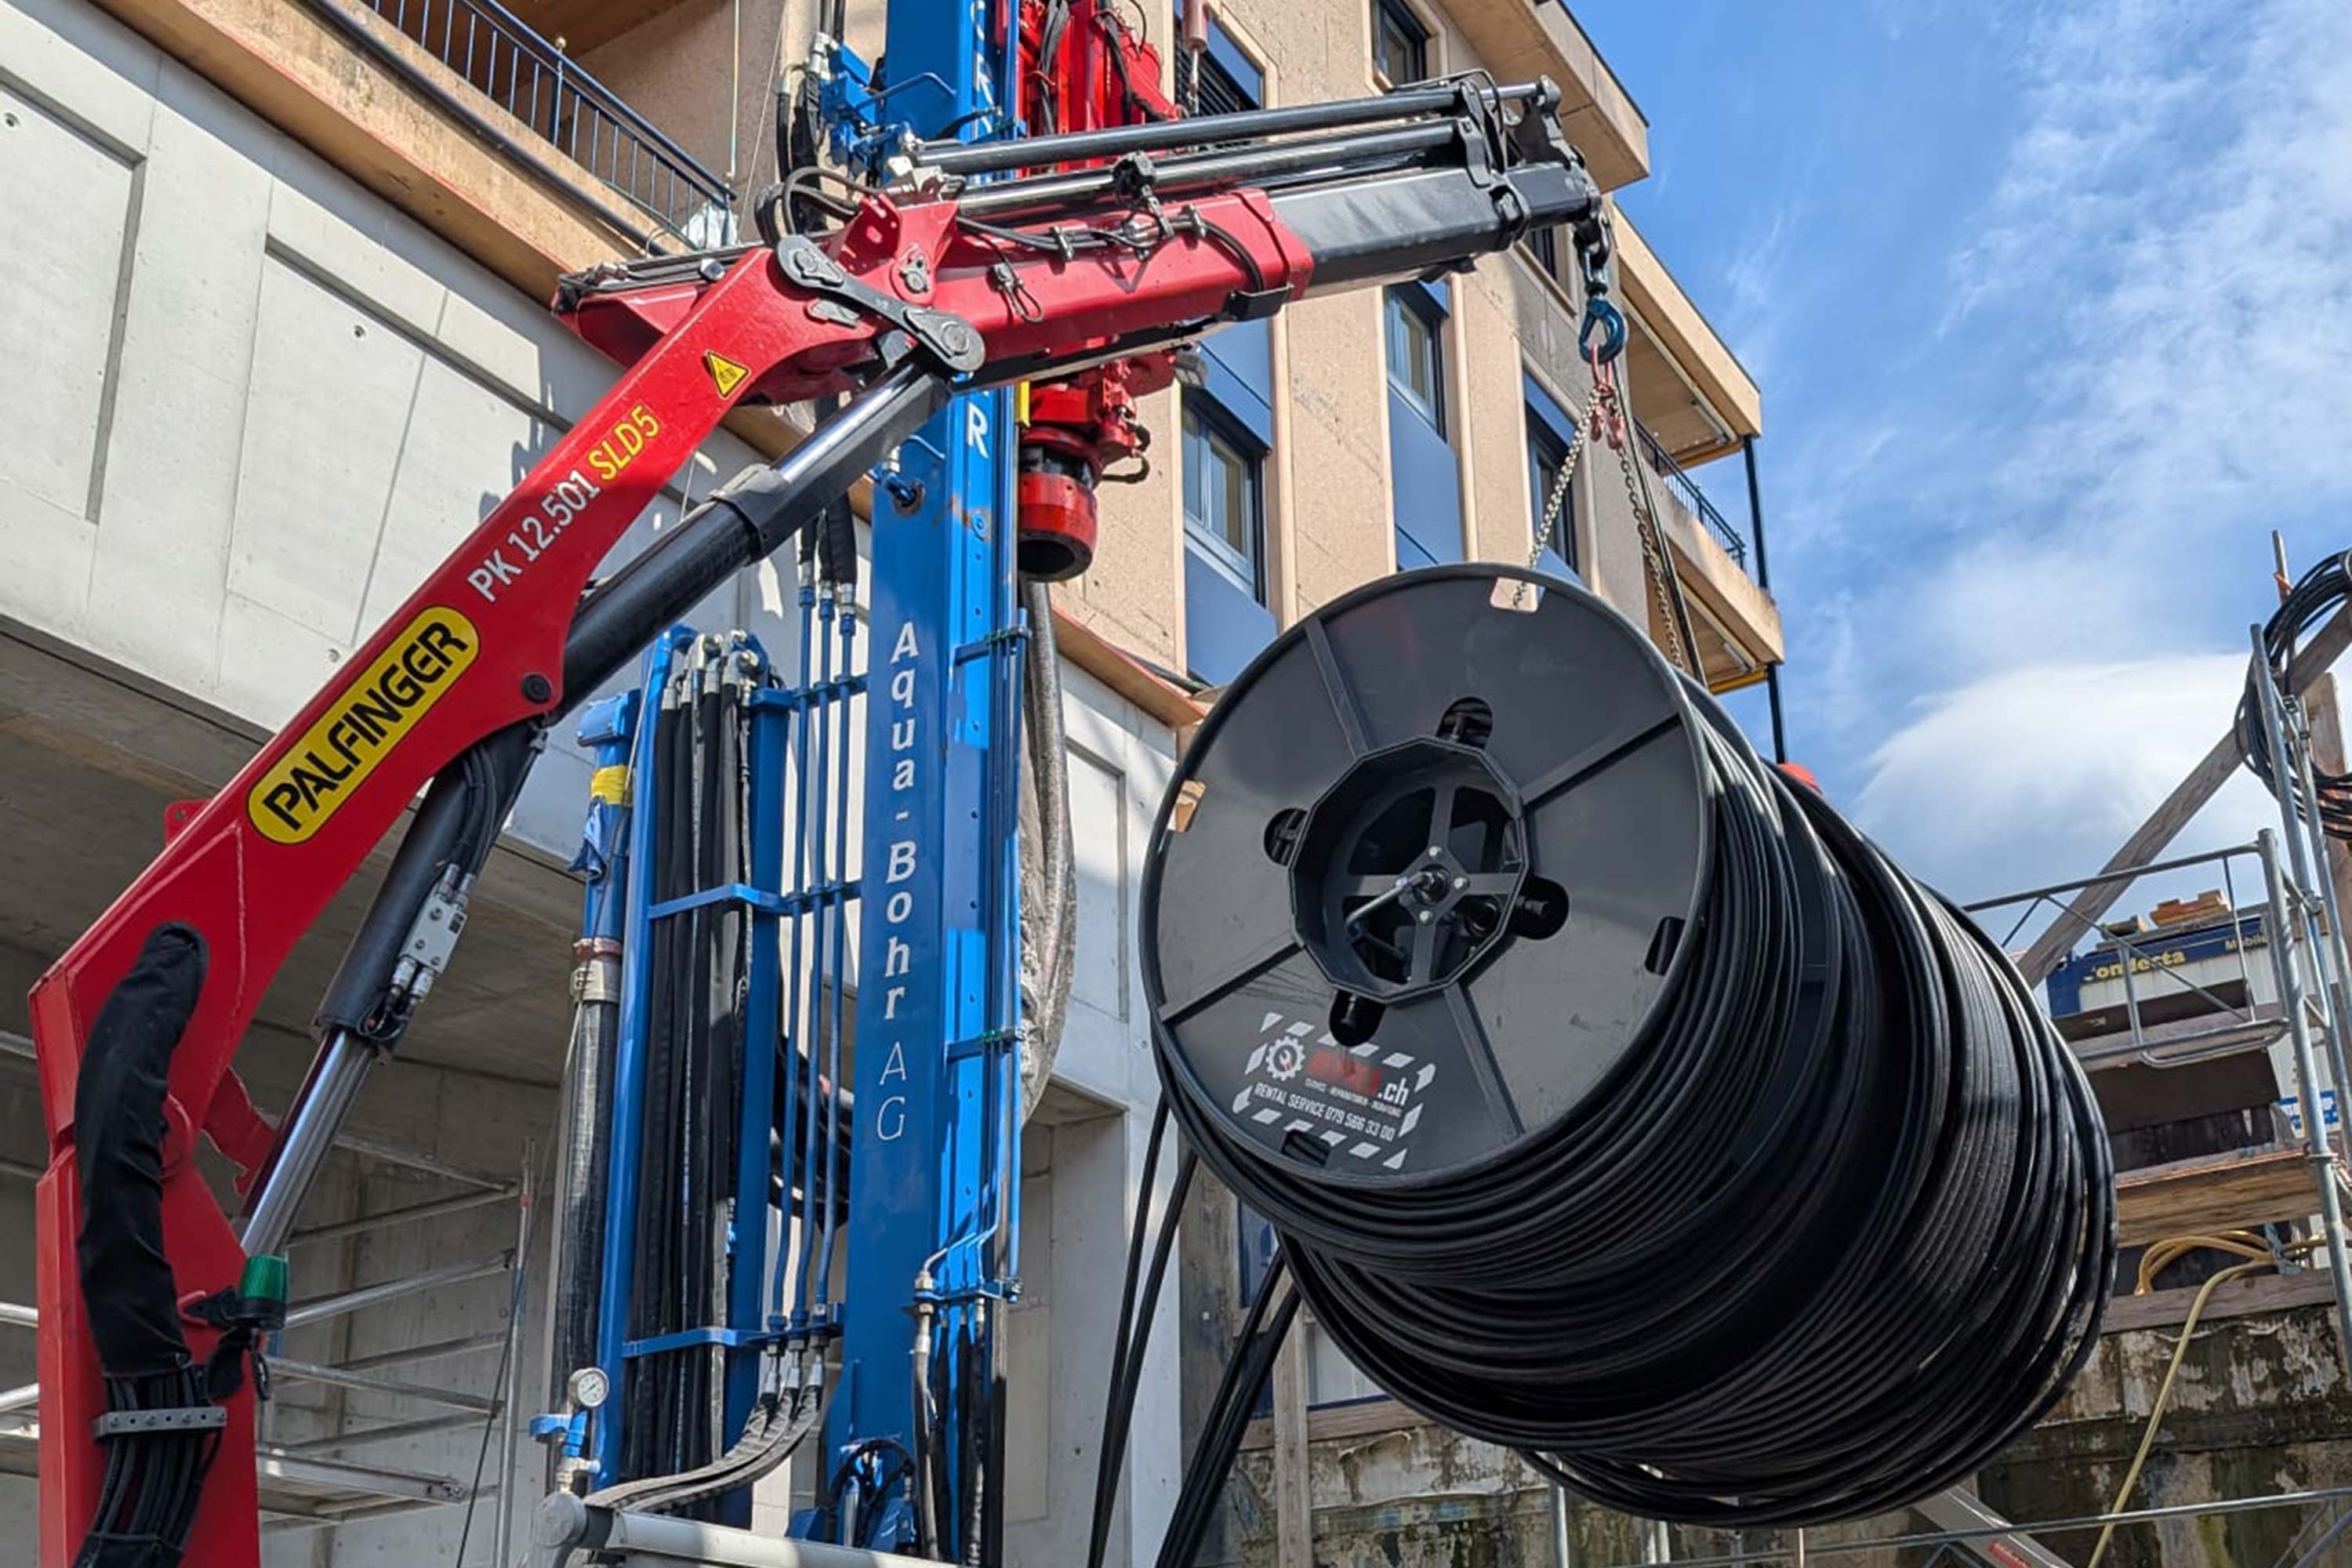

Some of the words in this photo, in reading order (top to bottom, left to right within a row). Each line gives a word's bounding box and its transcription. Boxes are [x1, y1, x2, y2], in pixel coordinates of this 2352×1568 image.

[467, 549, 522, 602] PK
[508, 470, 601, 562] 12.501
[262, 622, 469, 832] PALFINGER
[884, 621, 920, 1020] Aqua-Bohr
[876, 1040, 907, 1142] AG
[1254, 1082, 1288, 1106] RENTAL
[1287, 1093, 1327, 1119] SERVICE
[1324, 1106, 1346, 1125] 079
[1365, 1120, 1381, 1137] 33
[1379, 1124, 1396, 1142] 00
